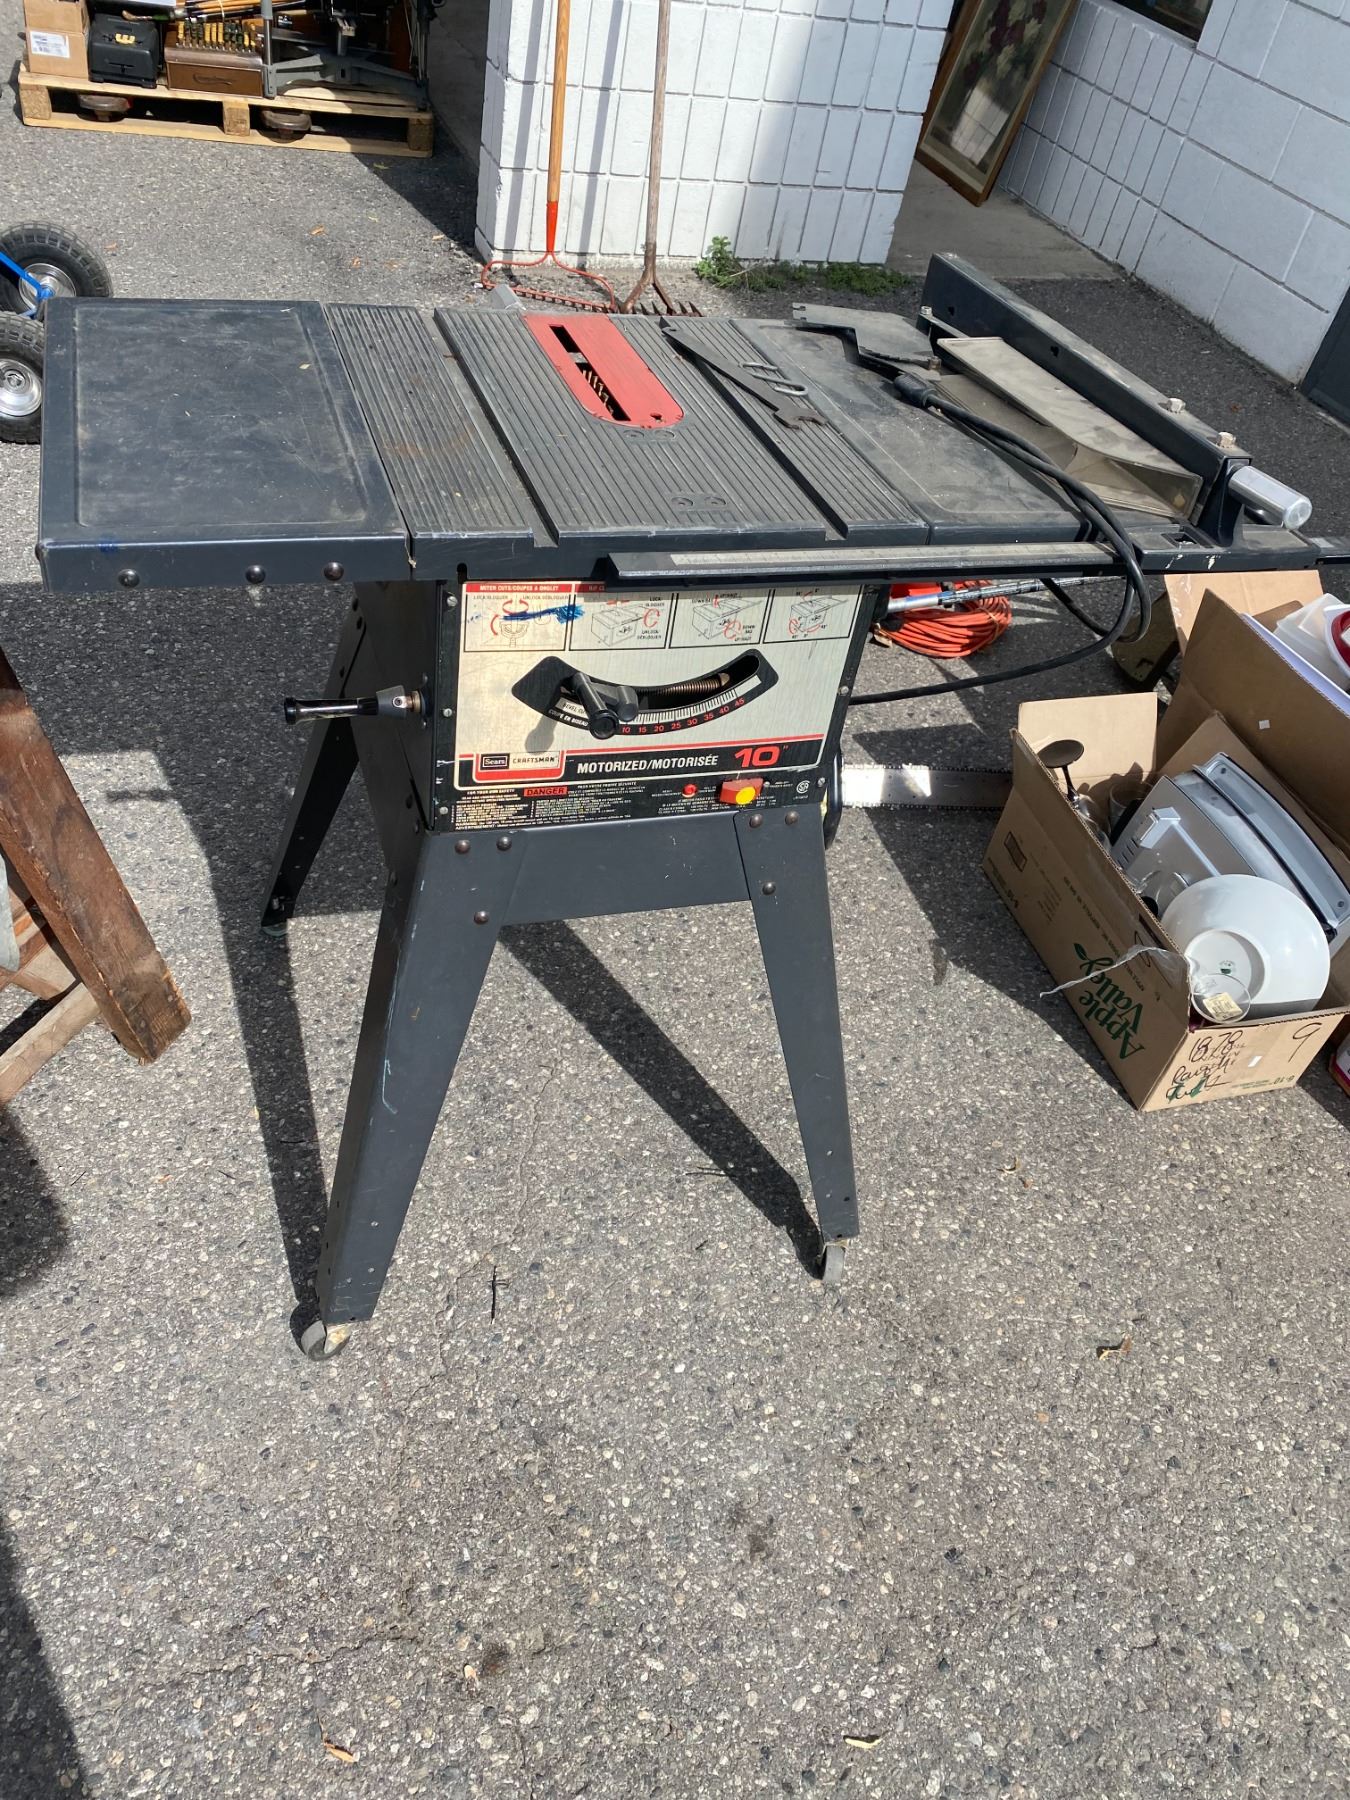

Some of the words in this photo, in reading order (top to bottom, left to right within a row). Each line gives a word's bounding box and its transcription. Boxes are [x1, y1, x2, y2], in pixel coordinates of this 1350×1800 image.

[719, 706, 730, 714] 40
[734, 698, 745, 707] 45
[512, 756, 555, 764] CRAFTSMAN
[526, 787, 565, 796] DANGER
[1078, 956, 1143, 1035] Valley
[1079, 990, 1145, 1060] Apple
[1287, 1022, 1323, 1063] 9
